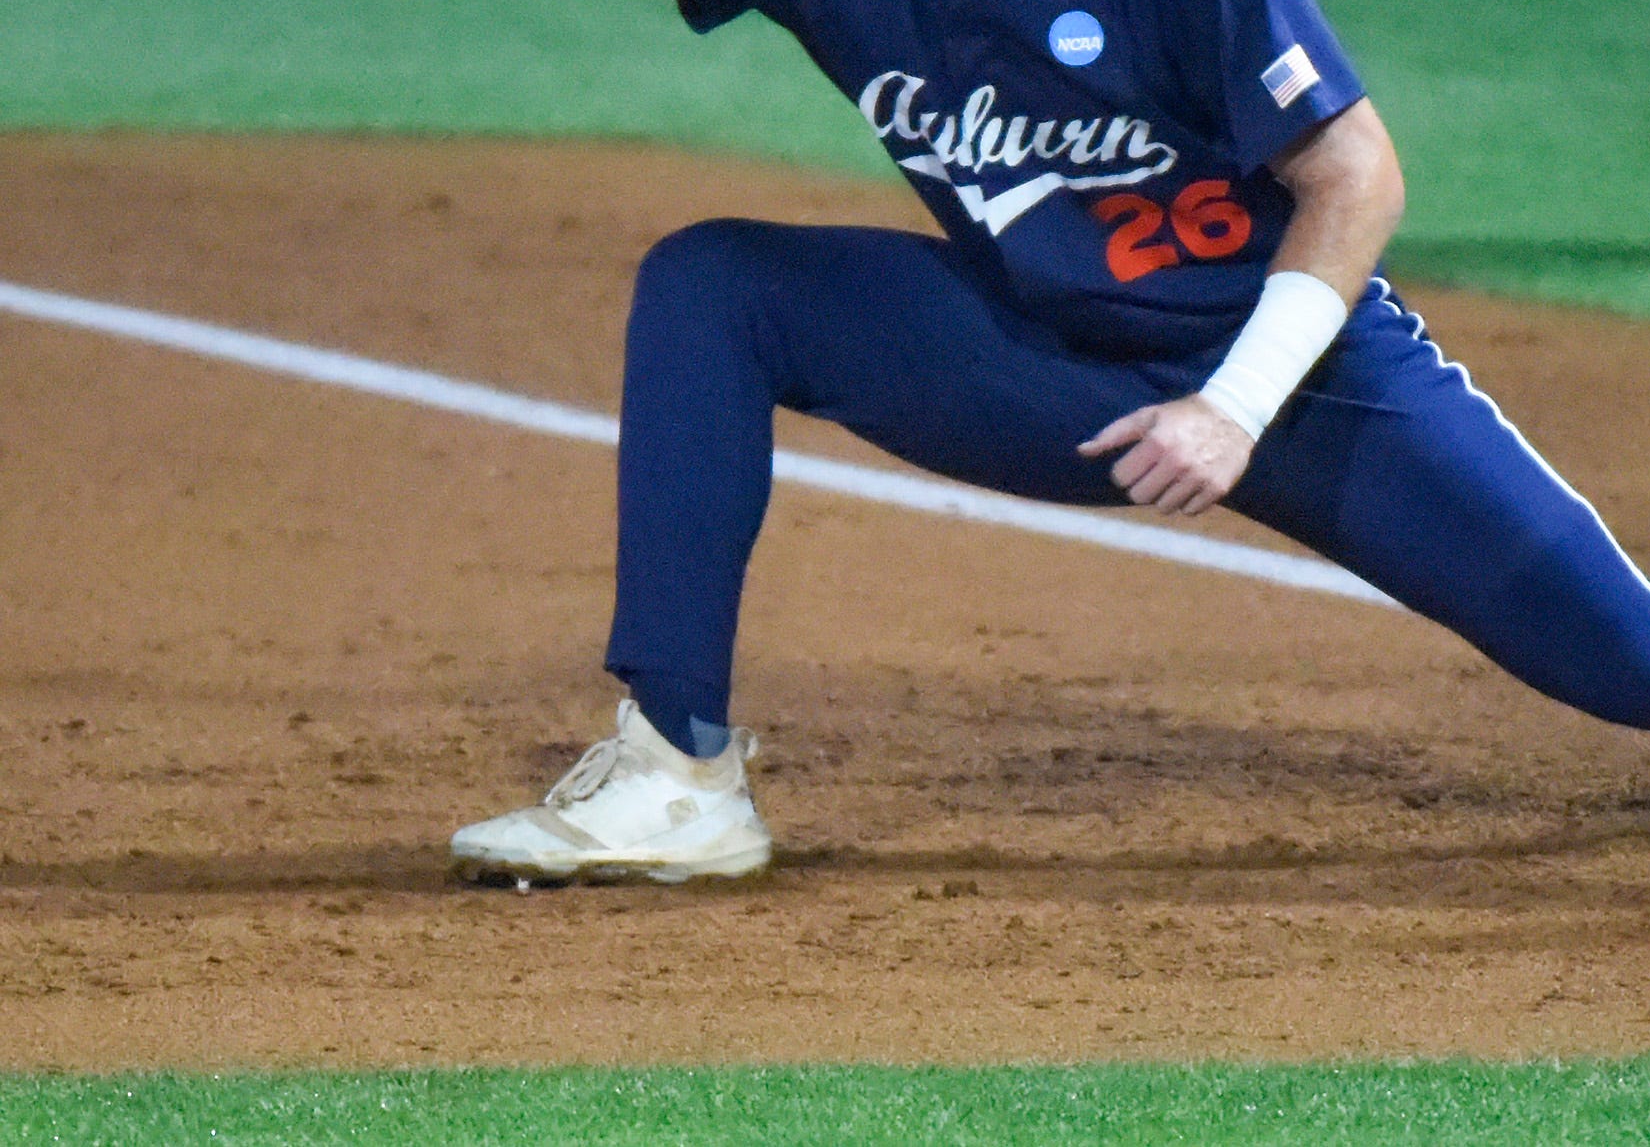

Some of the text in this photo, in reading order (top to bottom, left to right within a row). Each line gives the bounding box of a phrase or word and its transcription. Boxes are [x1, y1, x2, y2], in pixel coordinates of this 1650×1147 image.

[1057, 36, 1103, 52] NCAA
[859, 70, 1177, 178] Auburn
[1093, 179, 1252, 283] 26
